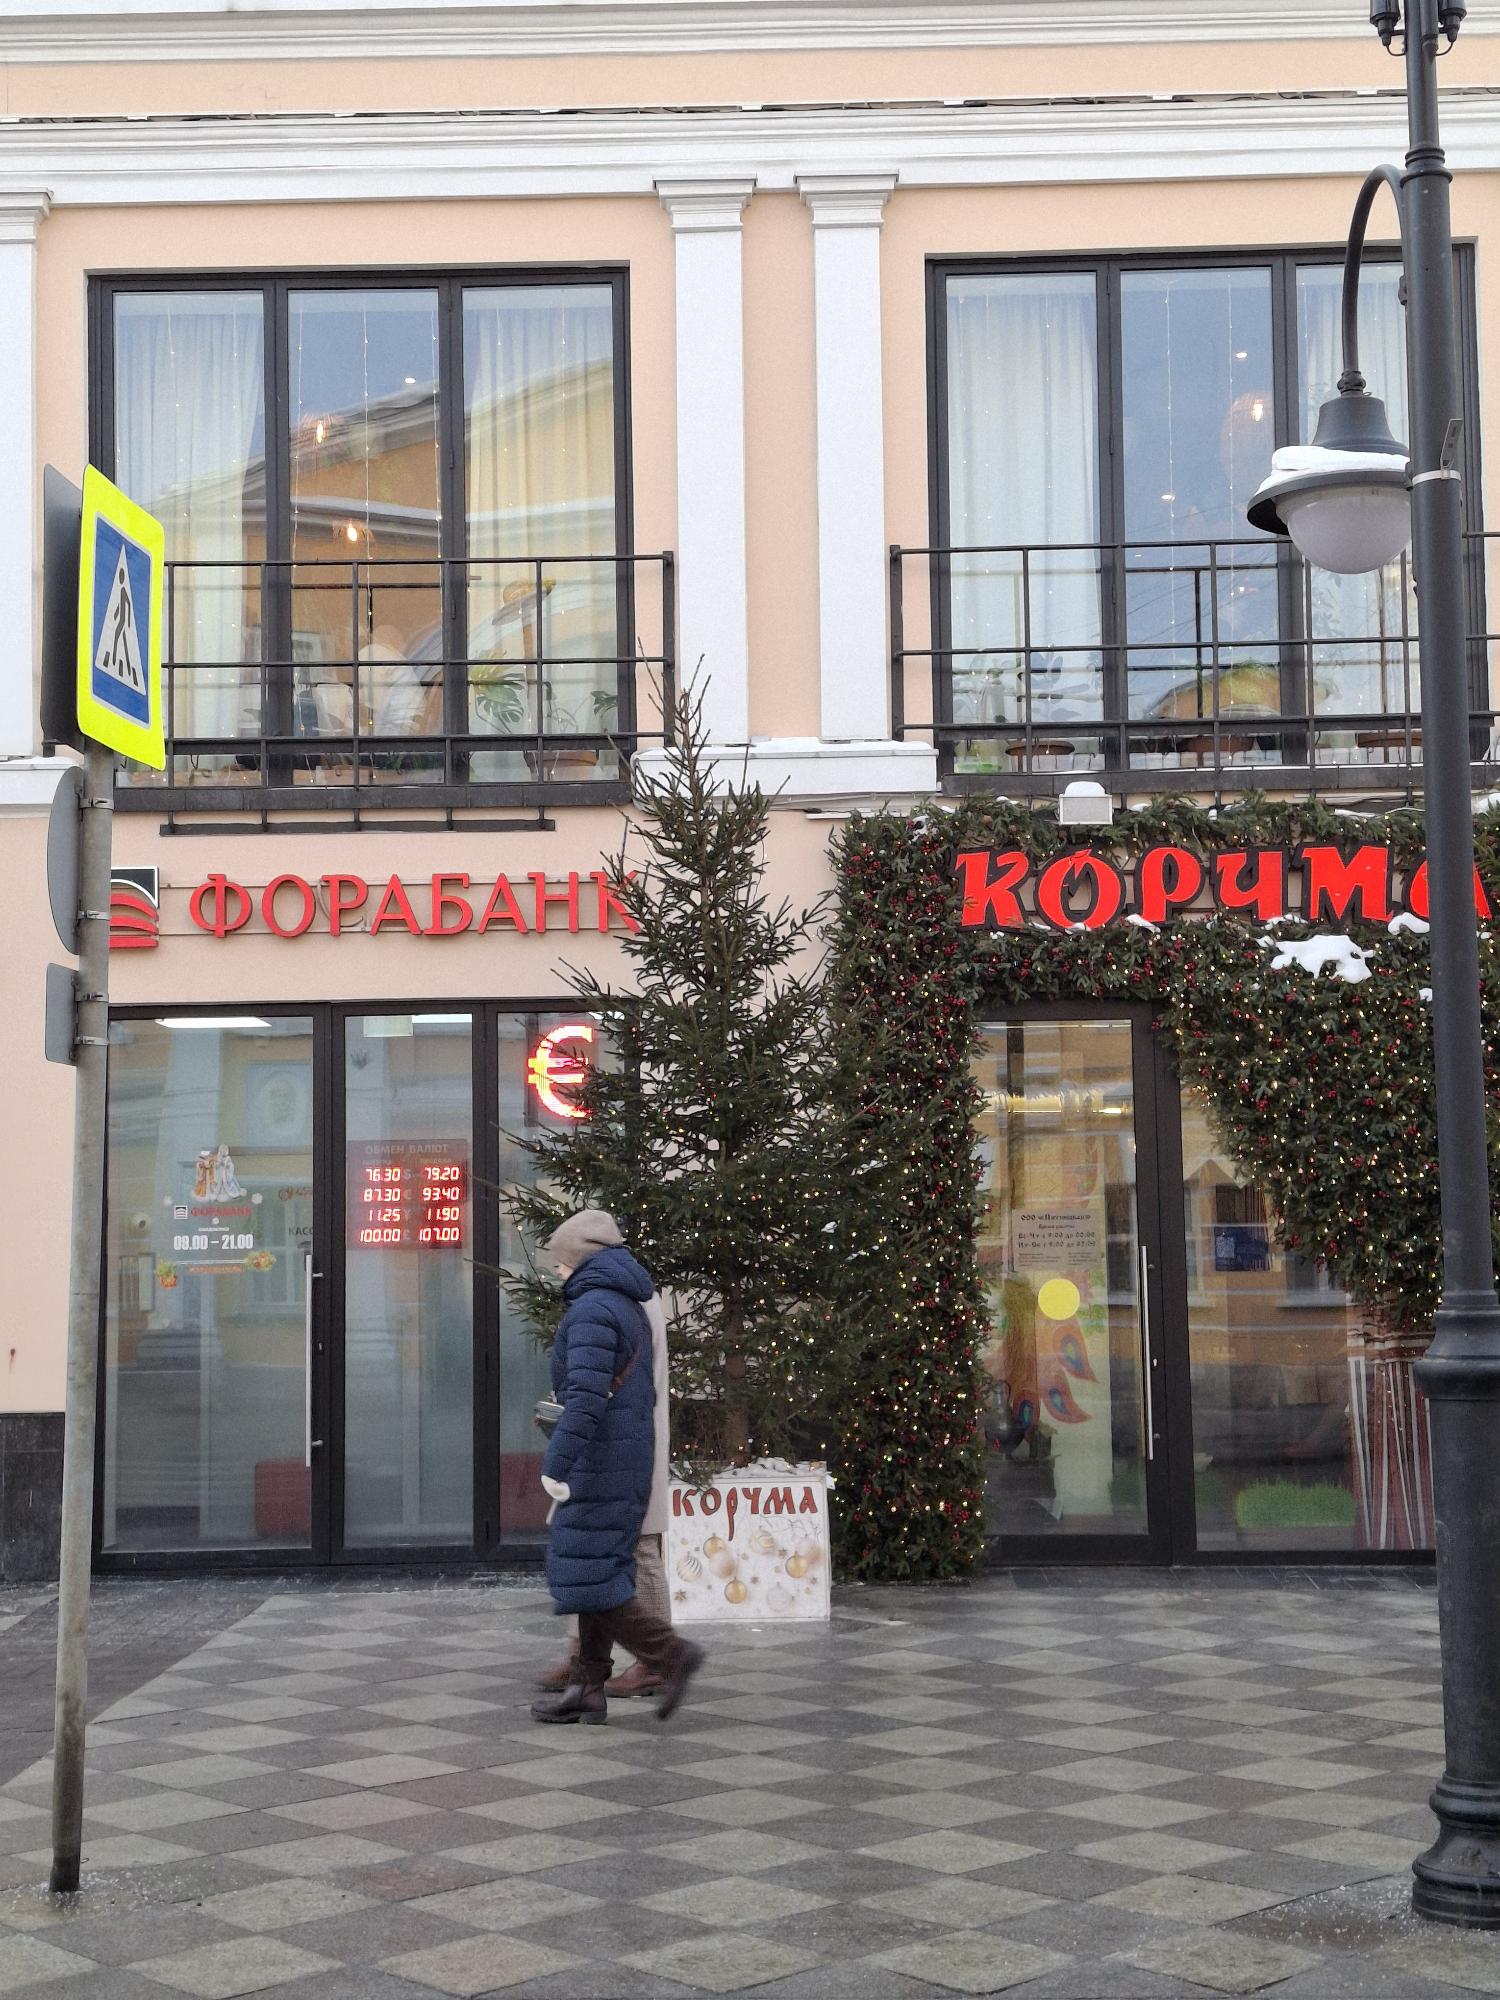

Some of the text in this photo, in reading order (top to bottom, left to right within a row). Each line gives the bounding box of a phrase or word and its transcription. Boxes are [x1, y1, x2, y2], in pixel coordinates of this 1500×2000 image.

[189, 871, 641, 938] ФОРАБАНК
[366, 1168, 401, 1181] 76.30
[425, 1167, 459, 1181] 79.20
[363, 1188, 401, 1202] 87.30
[423, 1187, 460, 1201] 93.40
[369, 1208, 401, 1221] 11.25
[427, 1207, 459, 1221] 11.90
[221, 1234, 254, 1250] 21.00
[360, 1228, 401, 1243] 100.00
[420, 1227, 459, 1241] 107.00
[672, 1486, 818, 1542] КОРЧМА
